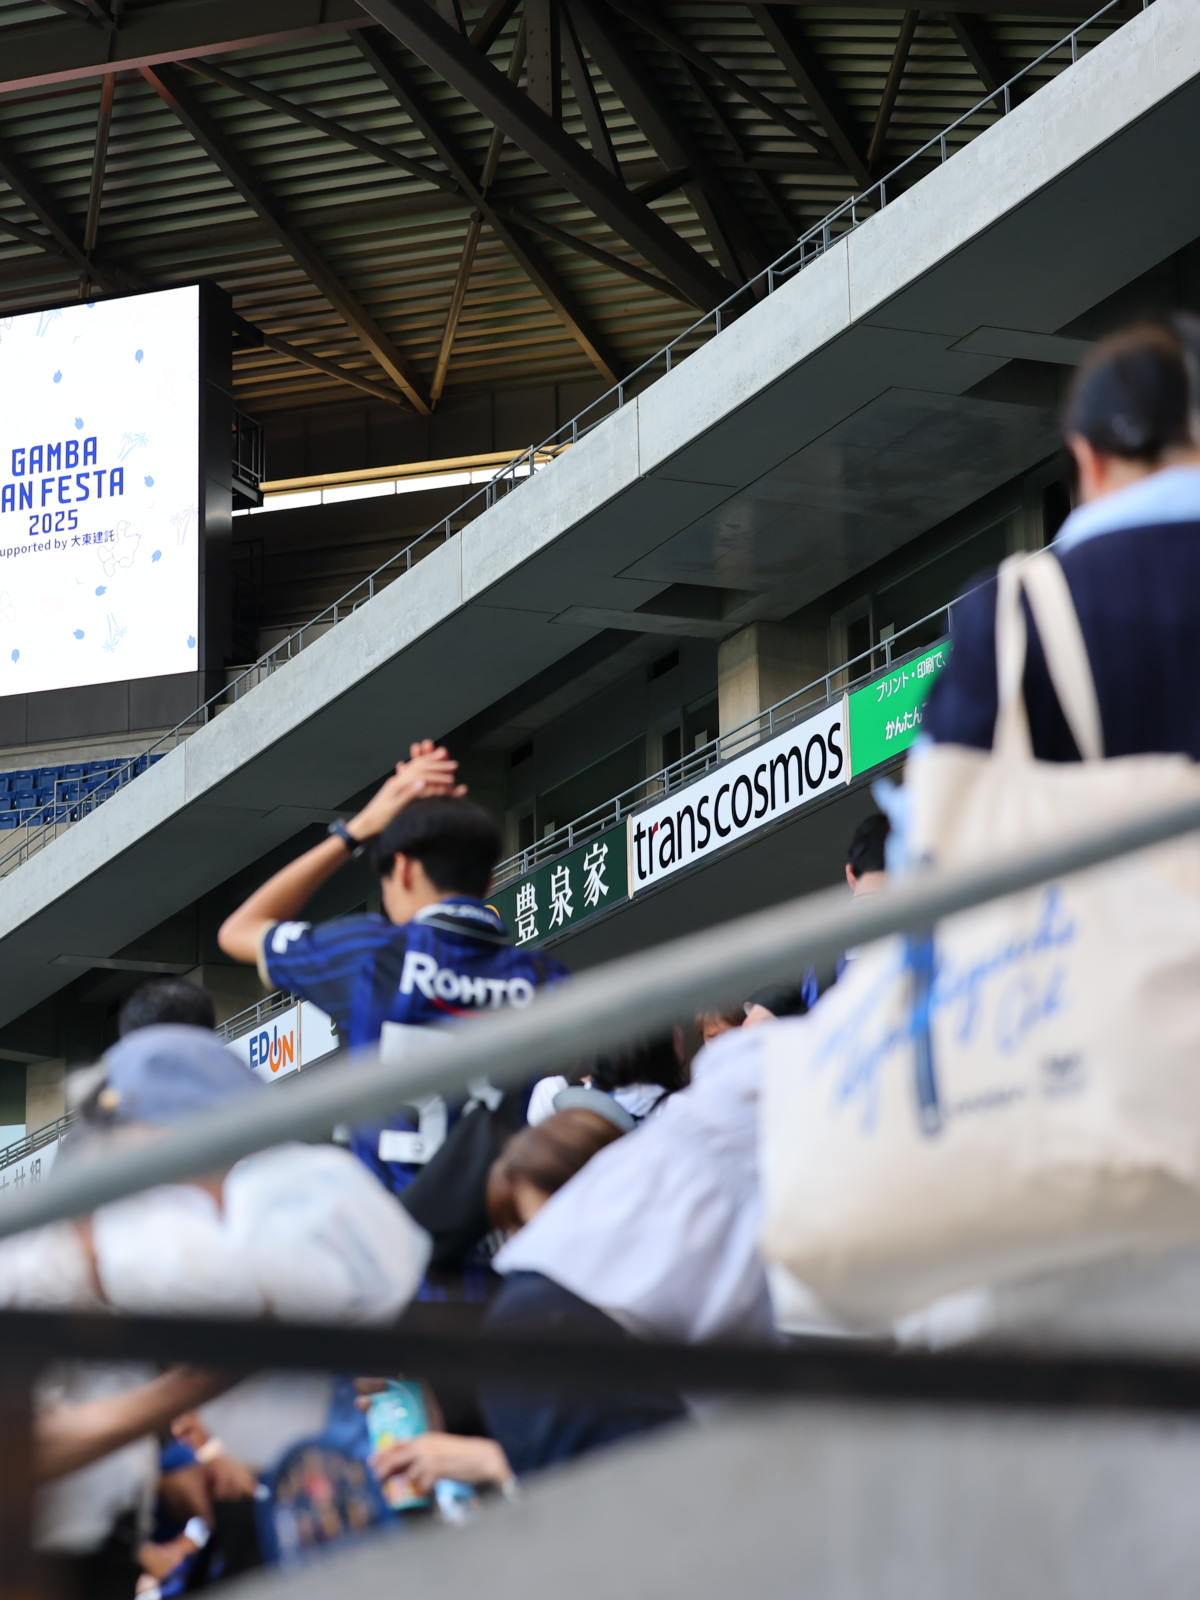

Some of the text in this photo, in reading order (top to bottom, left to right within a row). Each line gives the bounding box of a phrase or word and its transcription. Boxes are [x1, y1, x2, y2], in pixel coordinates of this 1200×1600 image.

[11, 436, 98, 477] GAMBA
[41, 466, 124, 507] FESTA
[29, 508, 78, 536] 2025
[54, 538, 68, 551] by
[71, 529, 115, 548] 大東建託
[633, 722, 844, 880] transcosmos
[514, 842, 610, 947] 豊泉家
[249, 1025, 295, 1073] EDION
